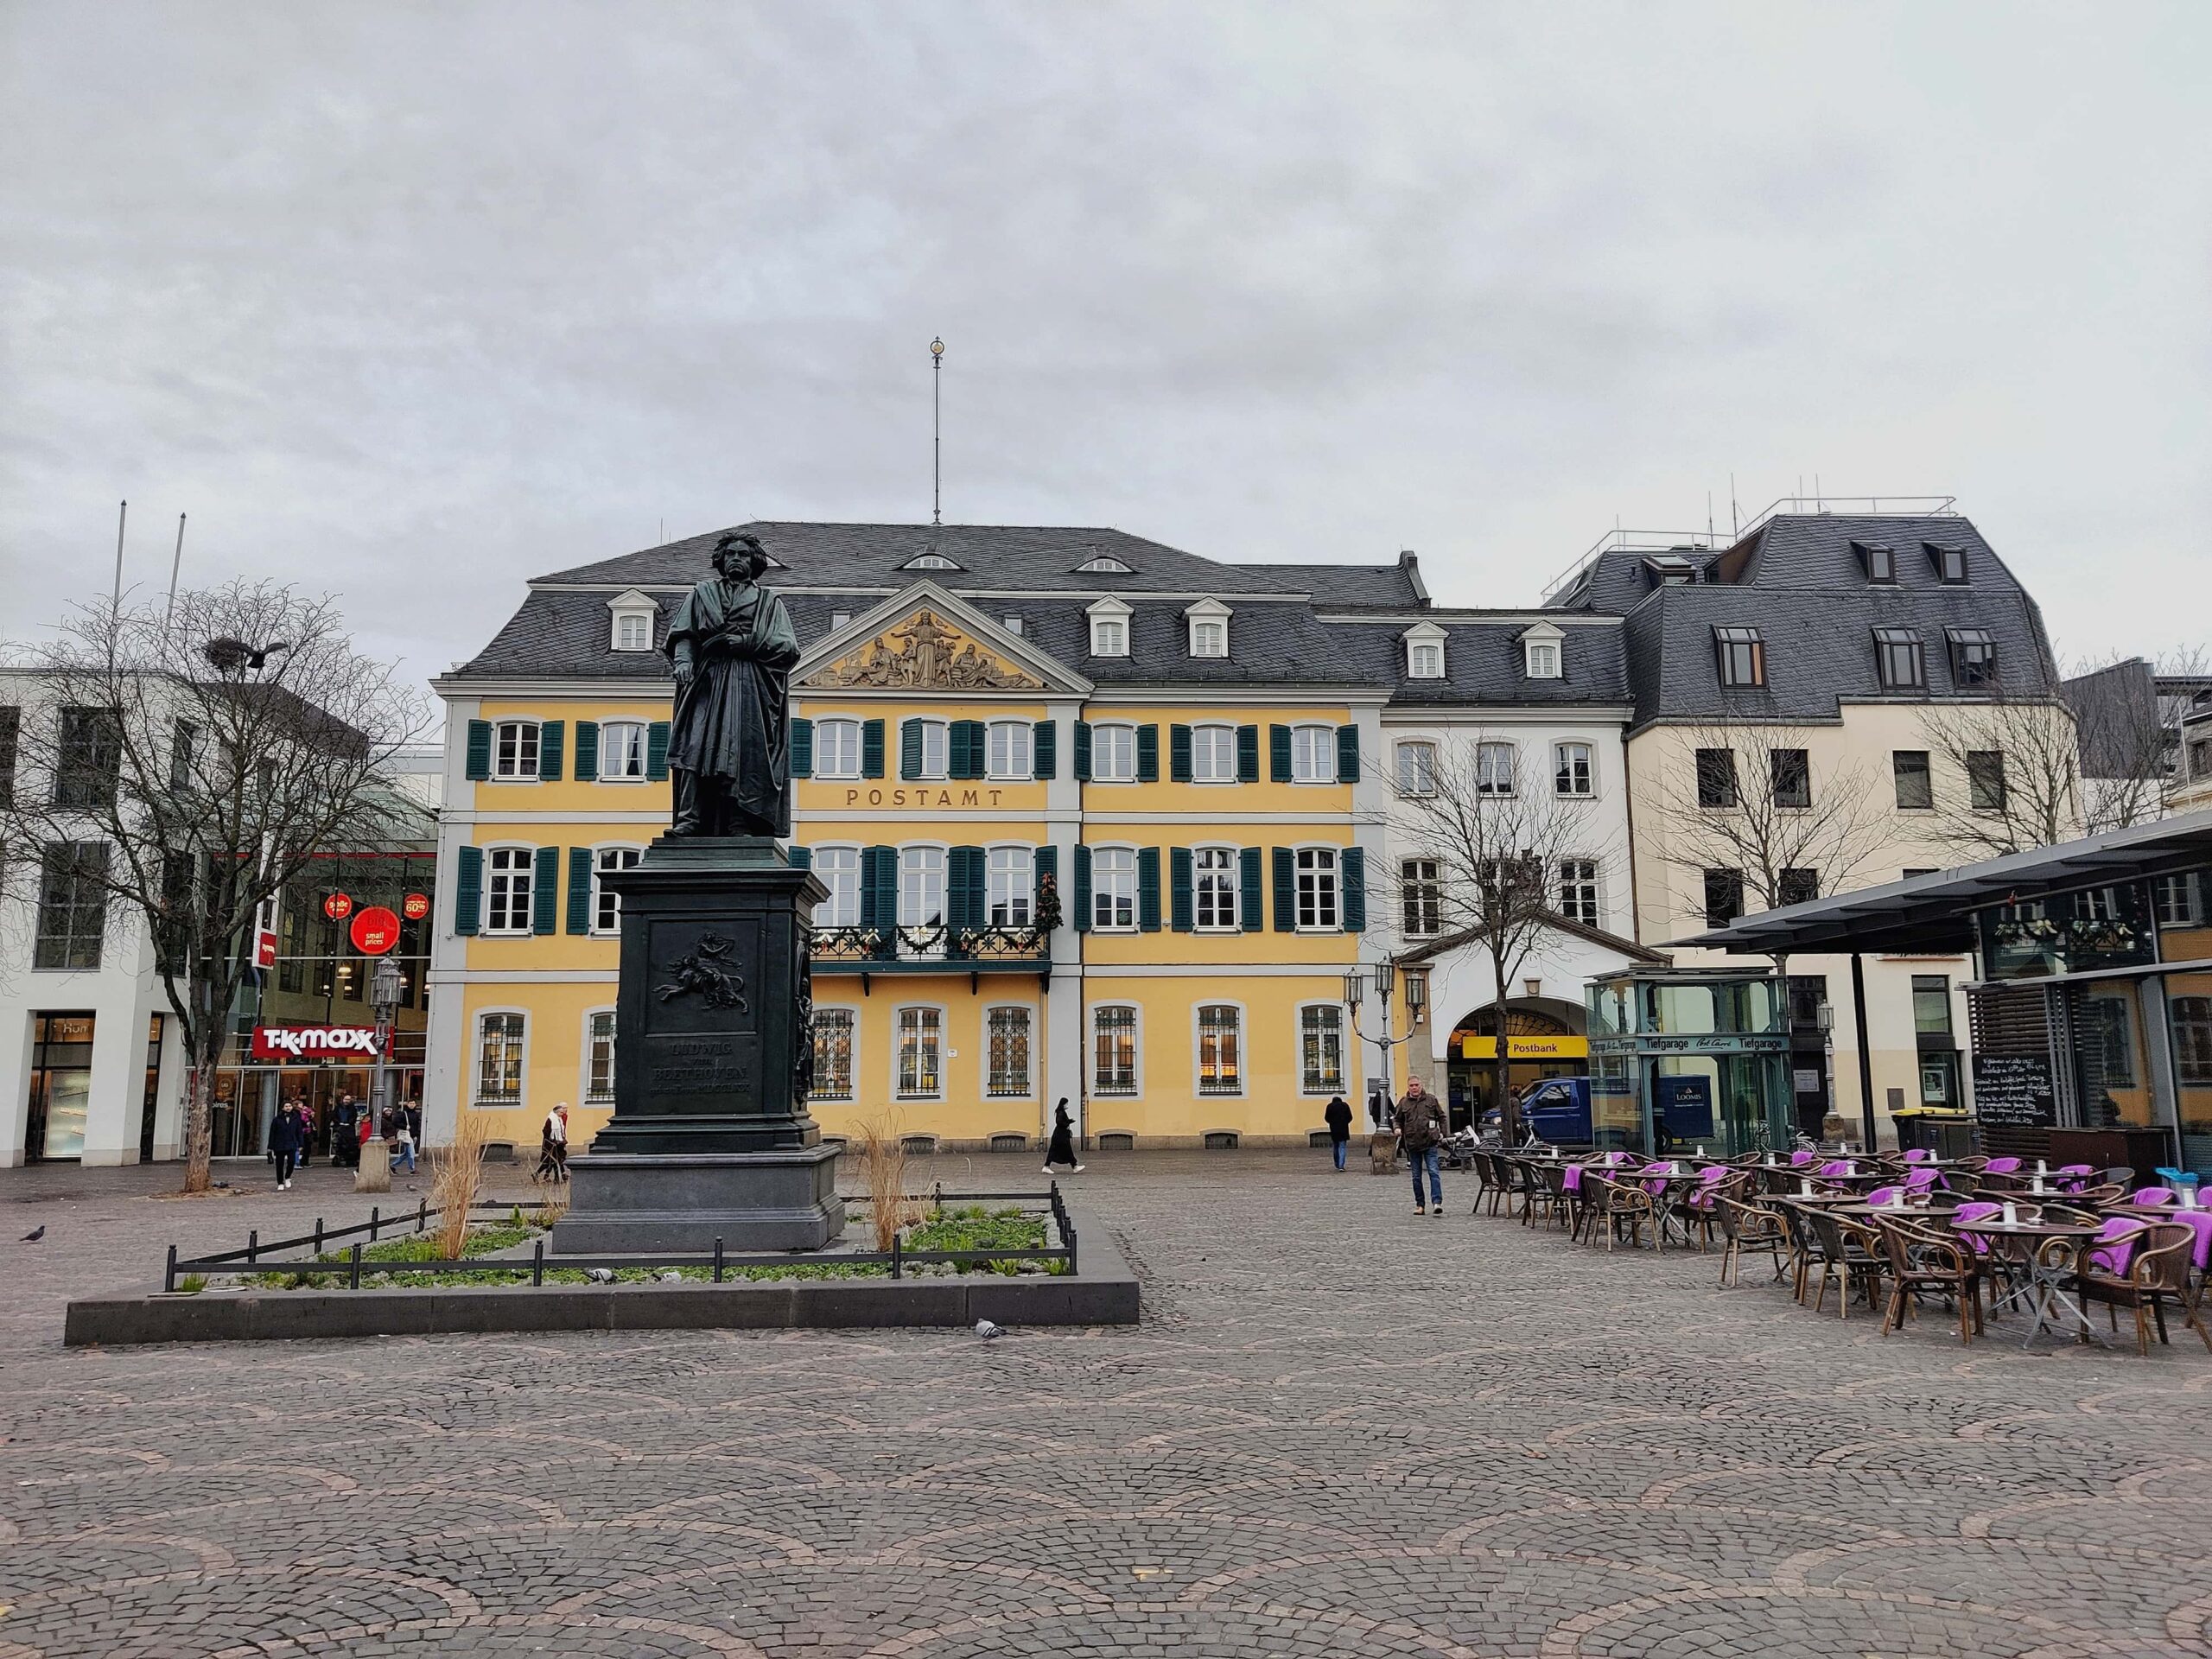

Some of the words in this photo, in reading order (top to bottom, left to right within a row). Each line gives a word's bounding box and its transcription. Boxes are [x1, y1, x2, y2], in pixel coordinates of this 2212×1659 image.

[846, 789, 1002, 805] POSTAMT
[1513, 1044, 1558, 1052] Postbank
[1645, 1038, 1689, 1050] Tiefgarage
[1738, 1038, 1783, 1050] Tiefgarage
